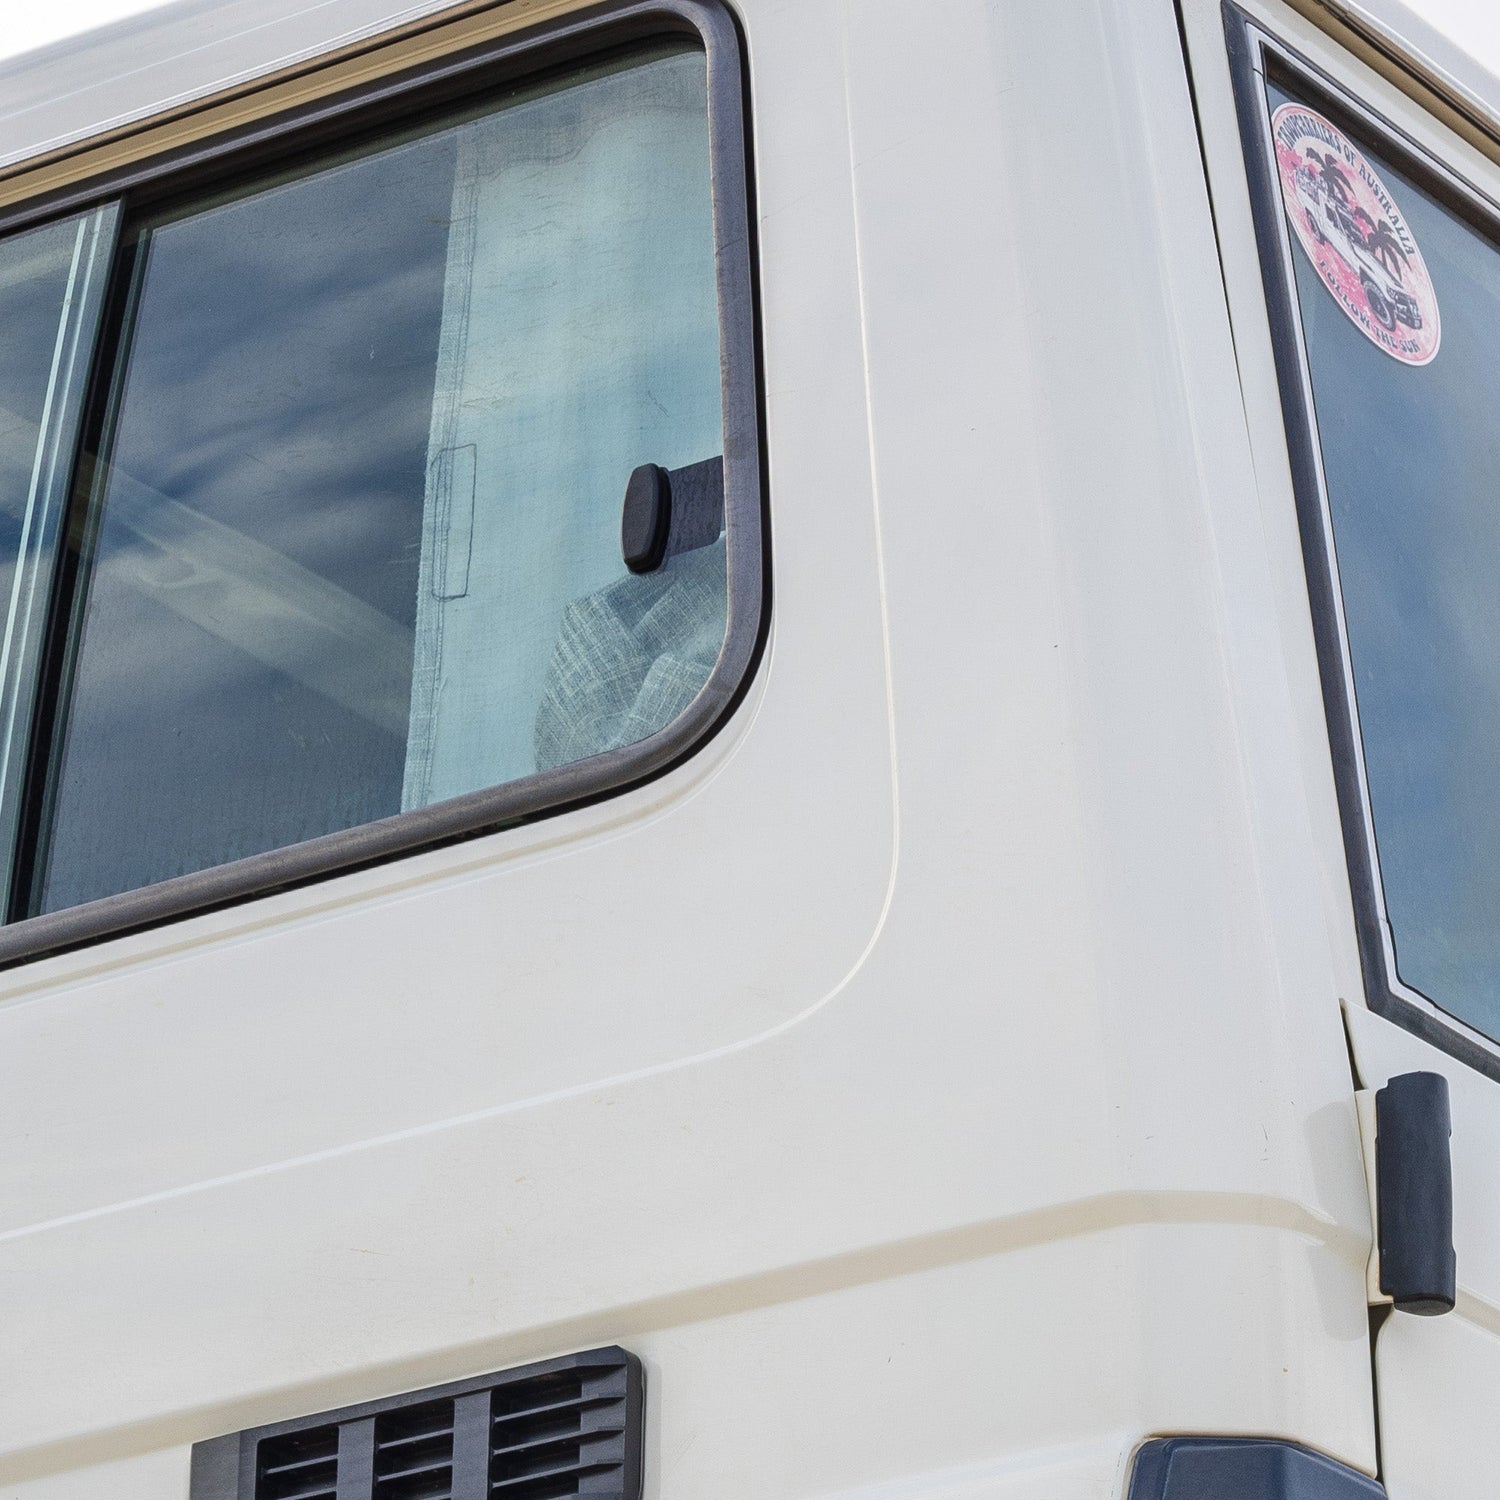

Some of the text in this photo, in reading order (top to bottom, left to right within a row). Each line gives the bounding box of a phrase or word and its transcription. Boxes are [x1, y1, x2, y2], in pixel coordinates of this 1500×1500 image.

[1343, 143, 1357, 168] OF
[1358, 165, 1416, 255] AUSTRALIA
[1319, 260, 1421, 354] FOLLOW THE SUN
